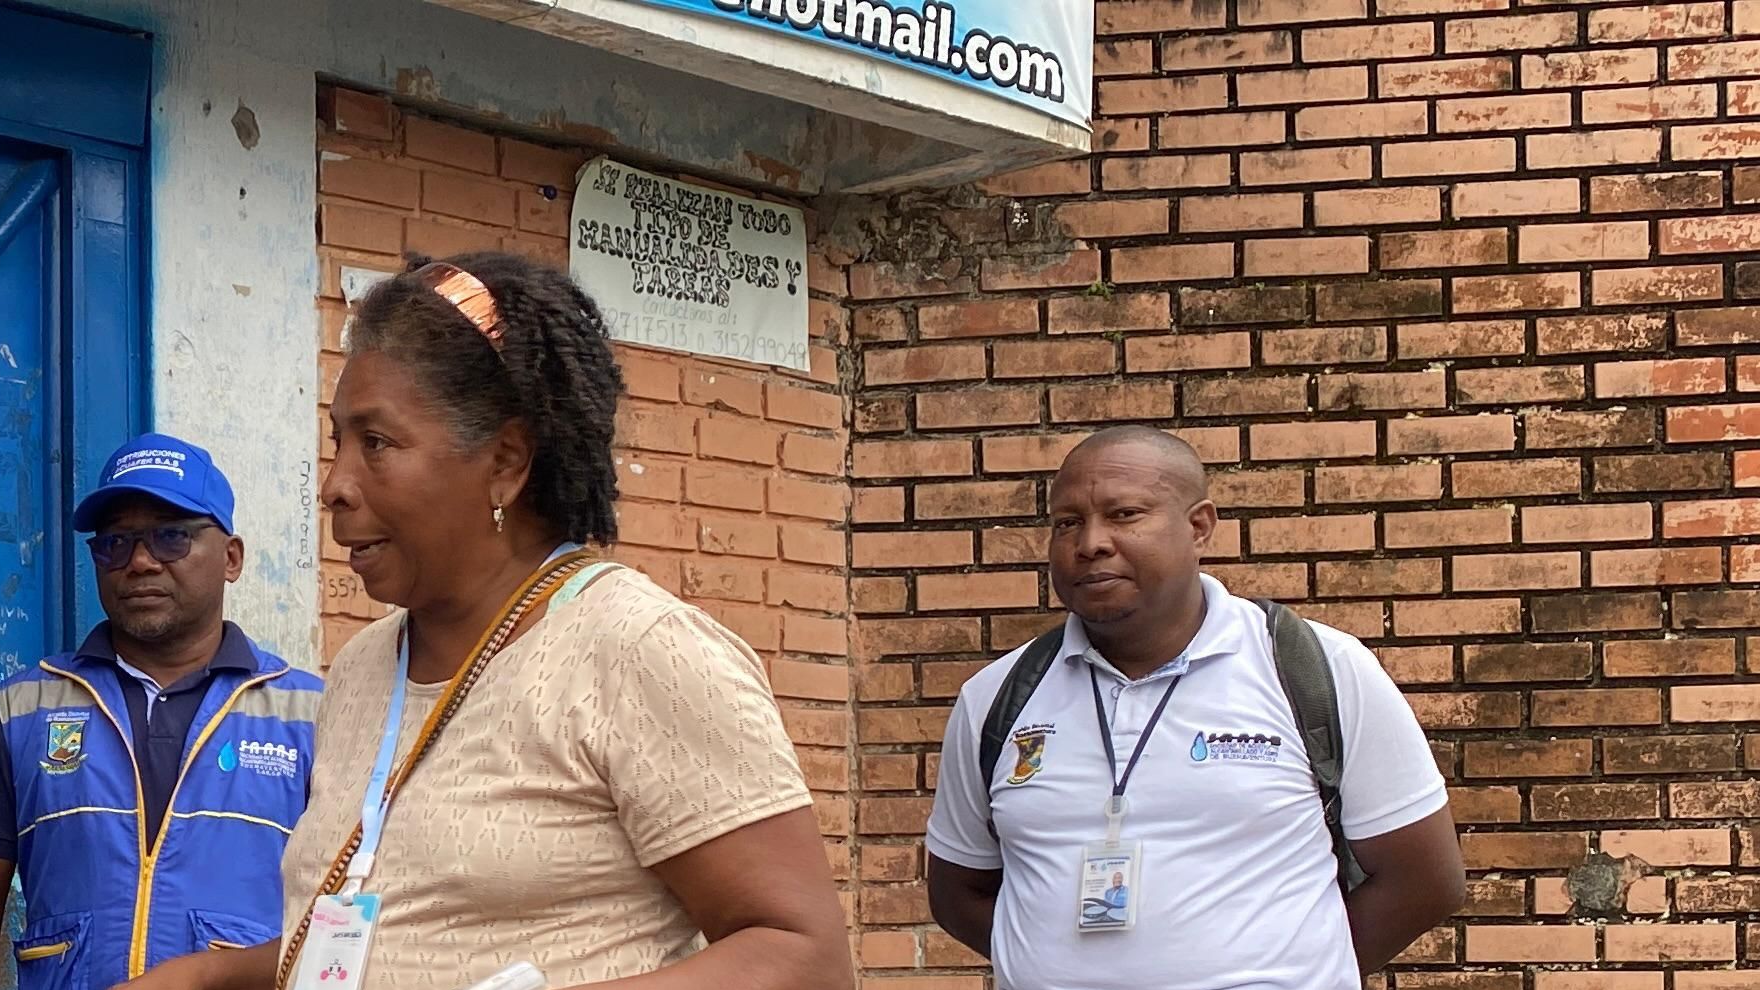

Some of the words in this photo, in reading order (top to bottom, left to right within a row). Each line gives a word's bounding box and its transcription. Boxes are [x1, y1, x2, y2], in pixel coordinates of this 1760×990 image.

[624, 173, 733, 226] REALIZAN
[631, 199, 692, 240] TIPO
[697, 219, 731, 250] DE
[577, 218, 779, 288] MANUALIDADES
[785, 258, 802, 296] Y
[631, 261, 731, 309] TAREAS
